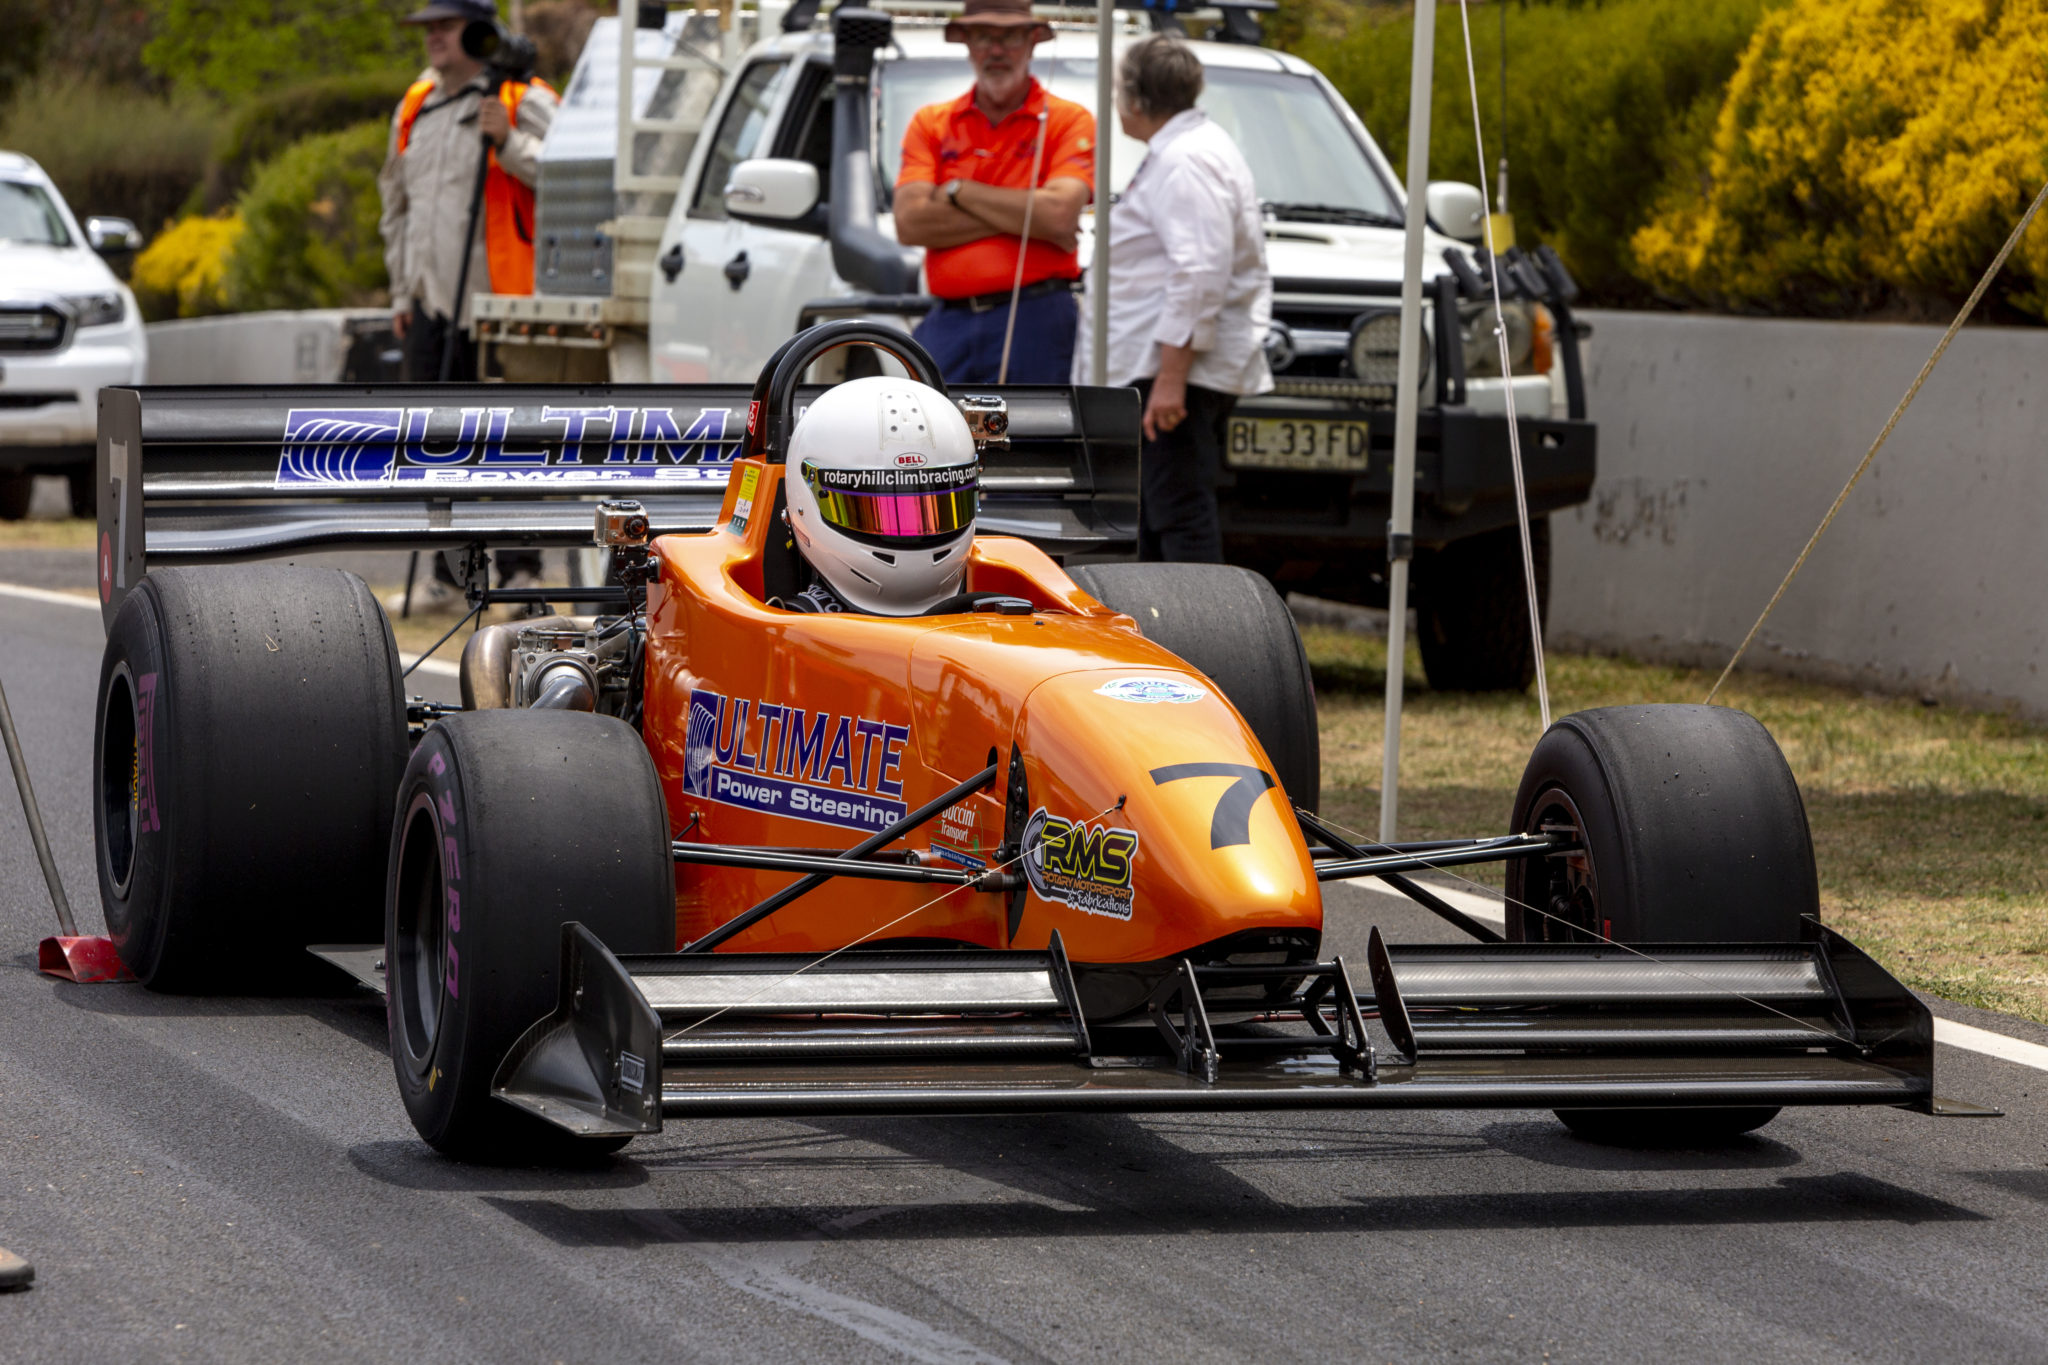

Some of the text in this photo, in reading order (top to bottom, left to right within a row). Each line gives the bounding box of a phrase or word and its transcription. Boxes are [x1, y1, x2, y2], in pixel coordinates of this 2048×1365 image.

[404, 406, 744, 465] ULTIM
[898, 456, 924, 465] BELL
[714, 695, 910, 799] ULTIMATE
[717, 772, 900, 831] Power Steering
[1149, 762, 1277, 851] 7
[941, 819, 969, 845] Transport
[1041, 821, 1135, 884] RMS
[438, 789, 462, 1000] ZERO
[1042, 871, 1132, 899] ROTARY MOTORSPORT
[1077, 889, 1130, 914] Fabrications
